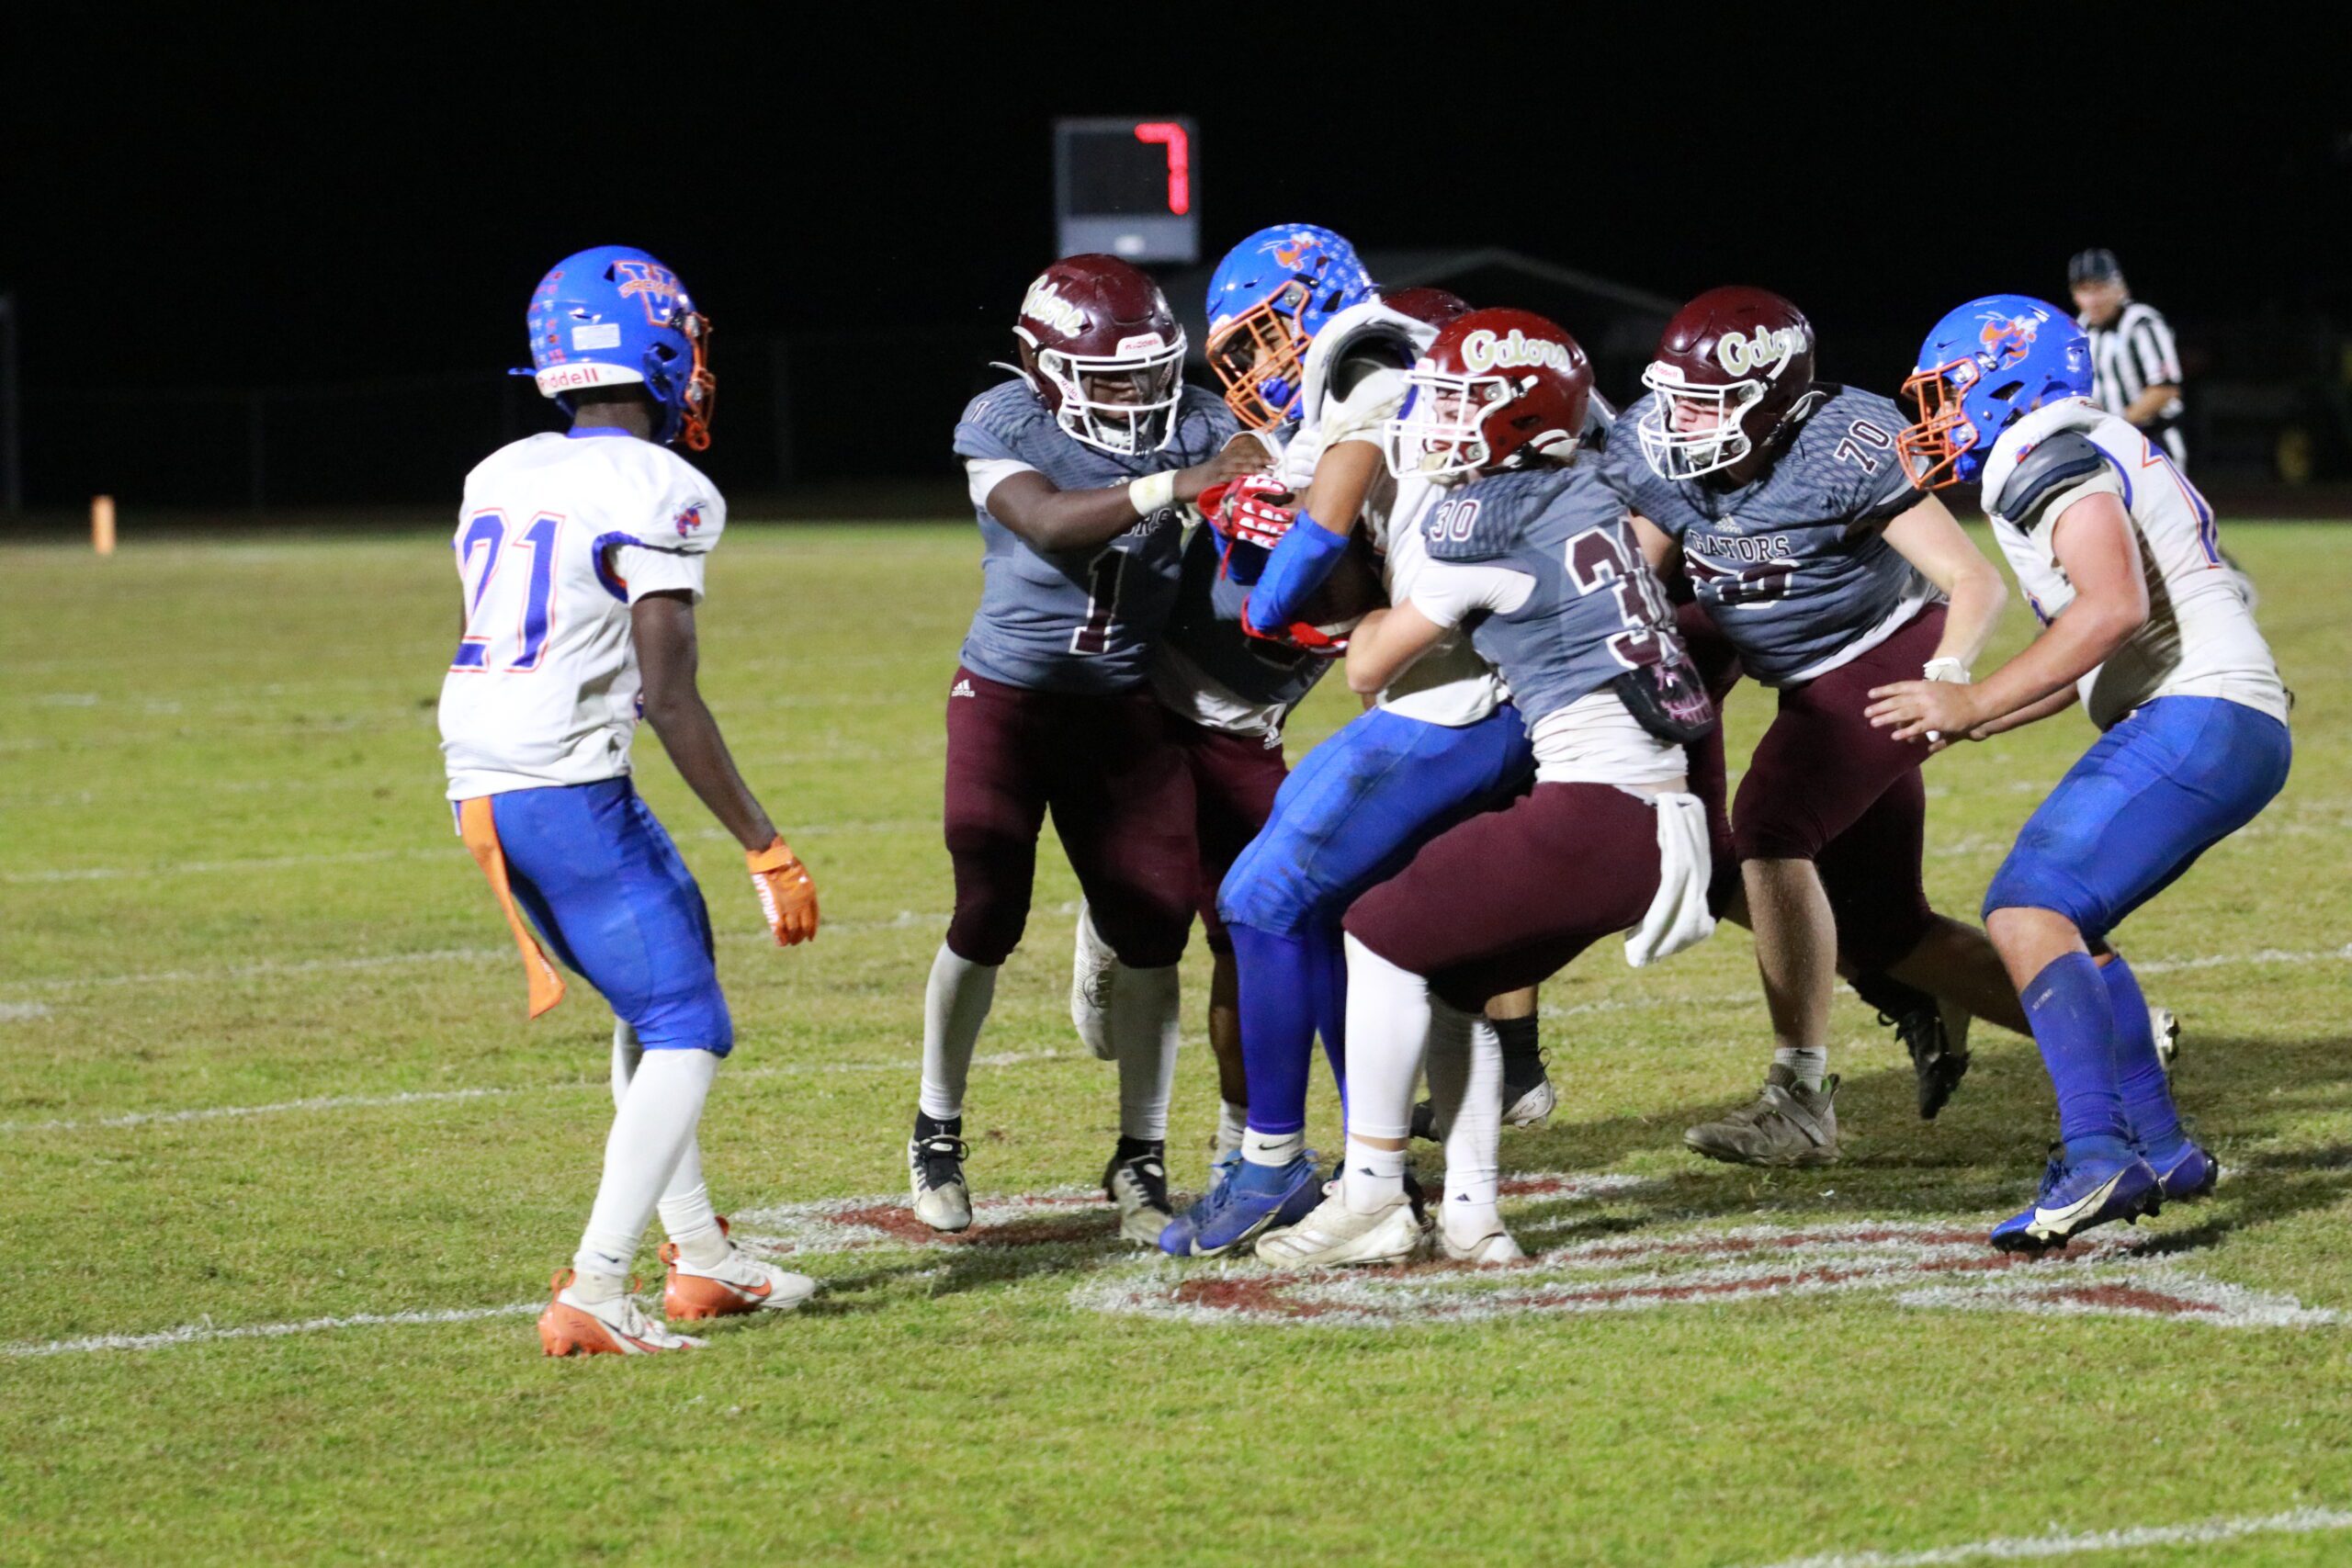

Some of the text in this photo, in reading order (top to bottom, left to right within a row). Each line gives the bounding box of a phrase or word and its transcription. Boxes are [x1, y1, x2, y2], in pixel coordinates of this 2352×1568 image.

[1134, 122, 1190, 216] 7
[538, 367, 599, 389] Rddell
[1835, 419, 1893, 475] 70
[1429, 499, 1481, 542] 30
[1688, 528, 1792, 563] GATORS
[448, 507, 567, 672] 21
[1069, 545, 1130, 655] 1
